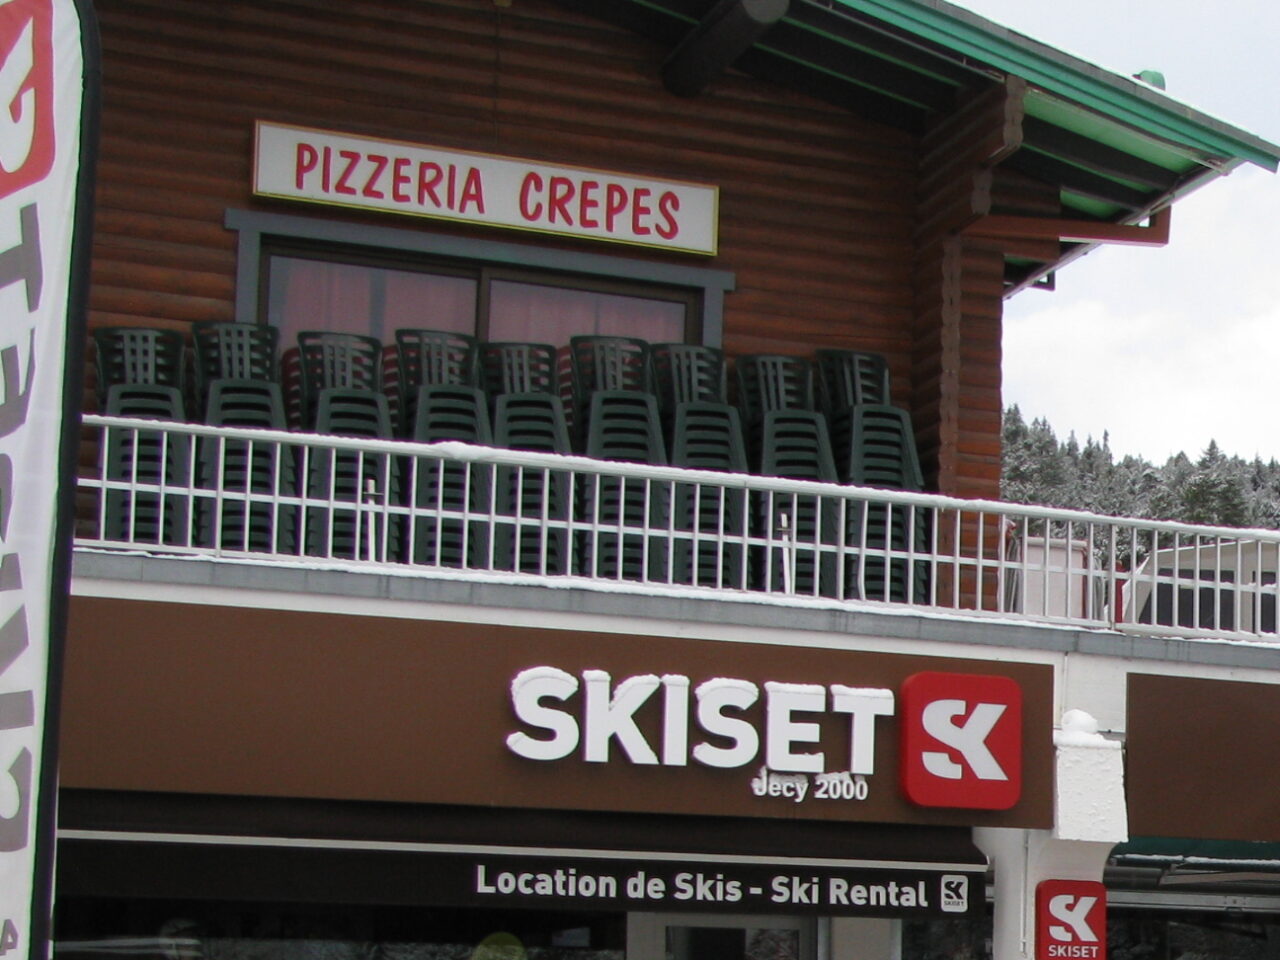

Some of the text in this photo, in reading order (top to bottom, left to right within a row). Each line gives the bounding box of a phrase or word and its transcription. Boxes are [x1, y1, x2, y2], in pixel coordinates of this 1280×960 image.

[296, 142, 680, 241] PIZZERIA CREPES
[507, 665, 895, 776] SKISET
[750, 766, 869, 803] Jecy 2000
[476, 864, 617, 898] Location
[626, 870, 666, 899] de
[674, 872, 743, 901] Skis
[771, 875, 820, 904] Ski
[829, 877, 929, 908] Rental
[1048, 944, 1099, 958] SKISET
